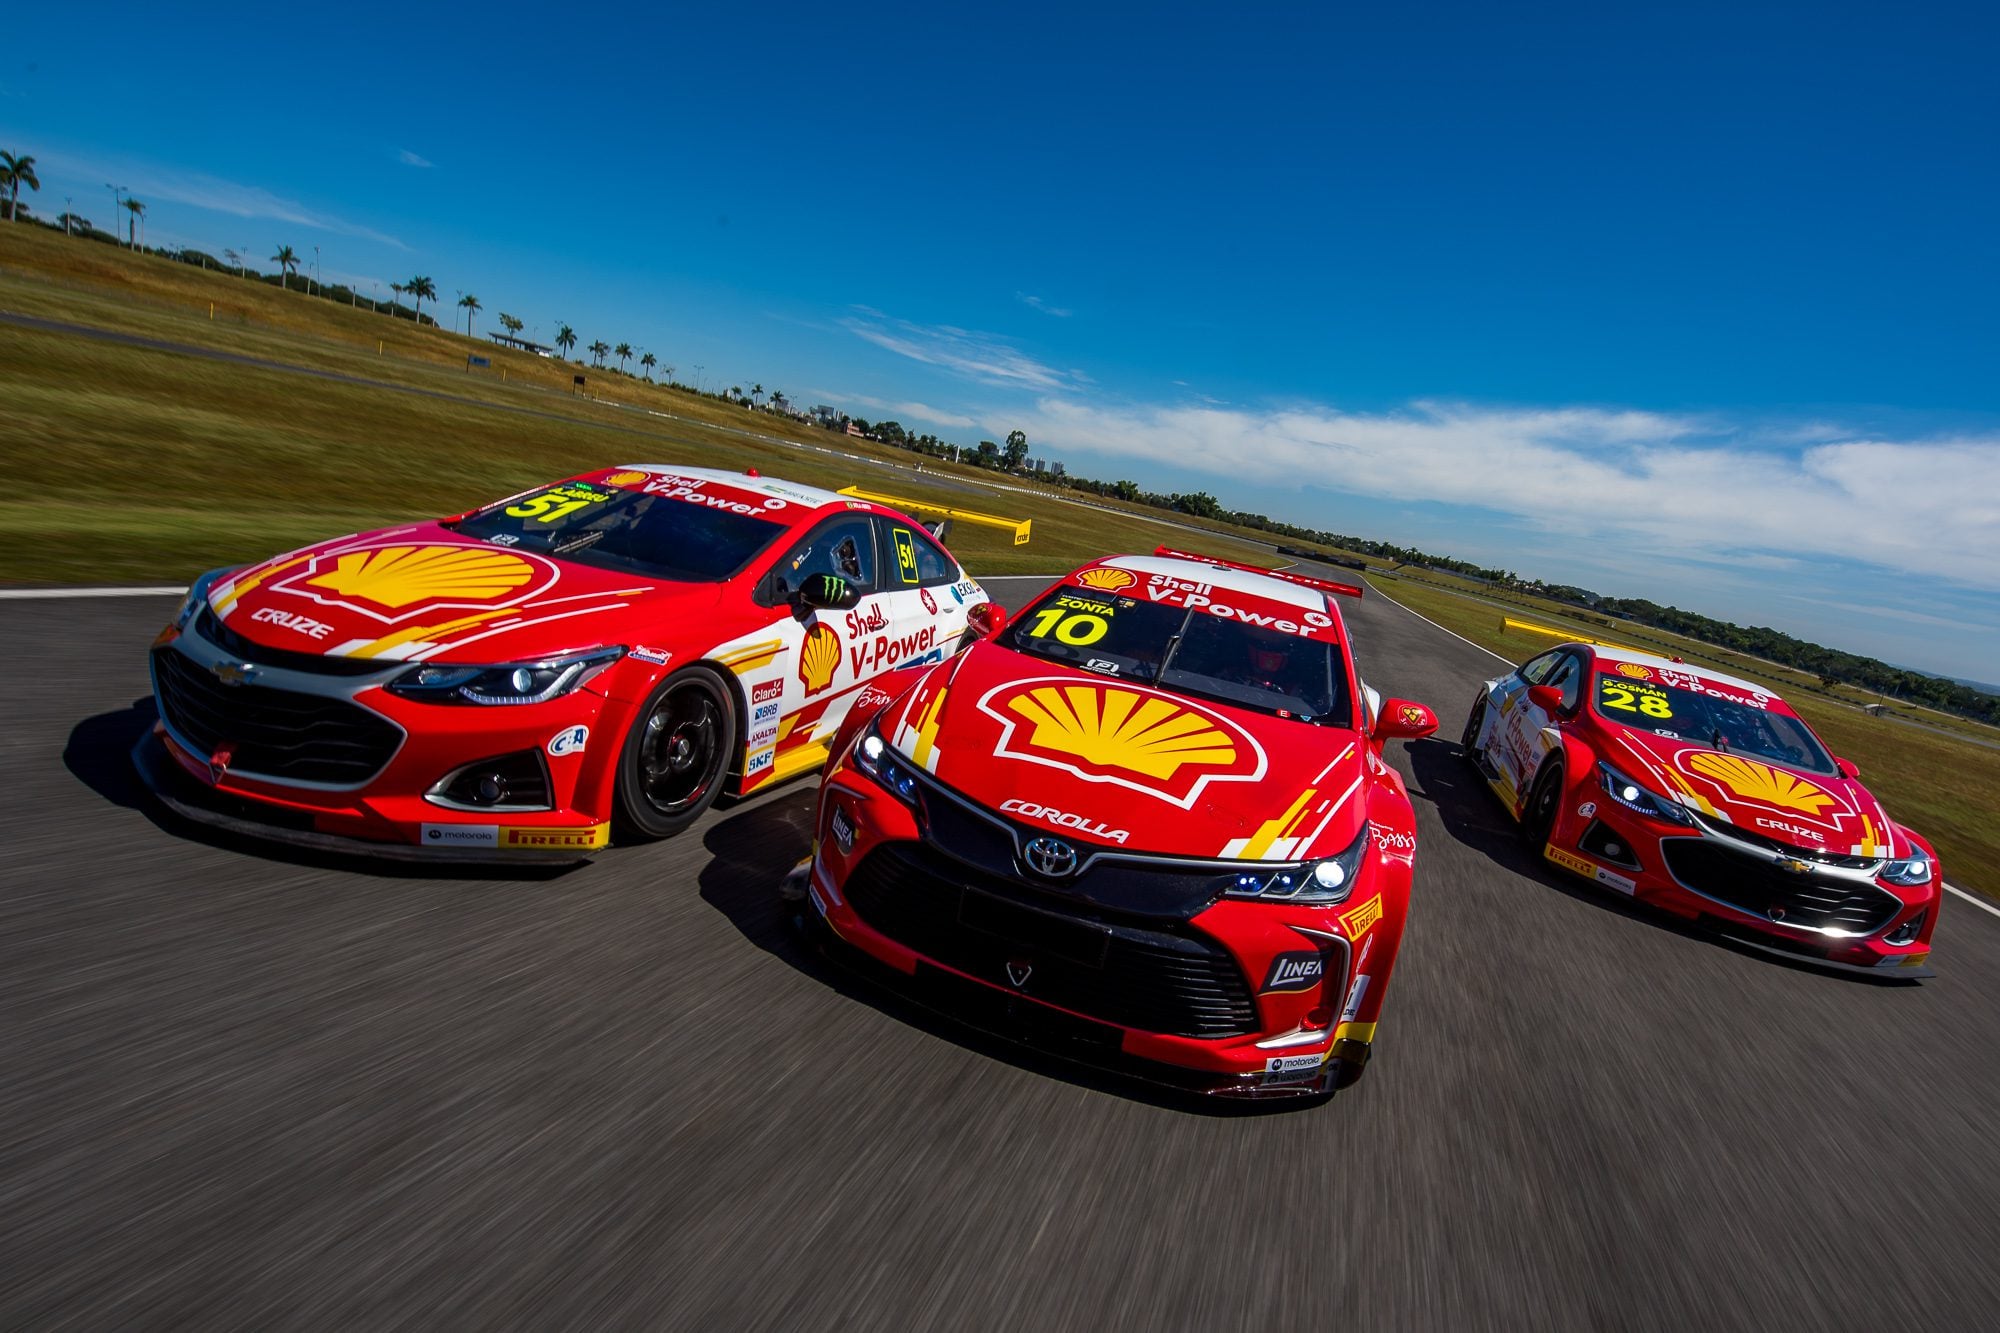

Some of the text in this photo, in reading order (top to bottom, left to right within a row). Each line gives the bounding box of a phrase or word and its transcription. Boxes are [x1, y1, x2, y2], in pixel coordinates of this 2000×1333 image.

[656, 475, 706, 489] Shell
[505, 493, 590, 523] 51
[643, 481, 766, 516] V-Power
[899, 544, 914, 569] 51
[1148, 575, 1213, 596] Shell
[1056, 597, 1114, 616] ZONTA
[1146, 585, 1317, 637] V-Power
[251, 607, 335, 640] CRUZE
[846, 603, 882, 640] Shell
[1030, 609, 1108, 646] 10
[850, 624, 937, 680] V-Power
[1658, 668, 1700, 684] Shell
[753, 687, 777, 703] Claro
[1603, 680, 1667, 699] G.OSMAN
[1659, 675, 1768, 710] V-Power
[762, 703, 778, 718] BRB
[1602, 687, 1673, 719] 28
[751, 727, 777, 744] AXALTA
[748, 751, 773, 772] SKF
[832, 809, 853, 847] LINEA
[999, 799, 1130, 844] COROLLA
[1756, 817, 1825, 843] CRUZE
[444, 831, 492, 841] motorola
[508, 829, 596, 845] PIRELLI
[1341, 897, 1380, 938] PIRELLI
[1270, 958, 1322, 987] LINEA
[1284, 1056, 1320, 1068] motorola
